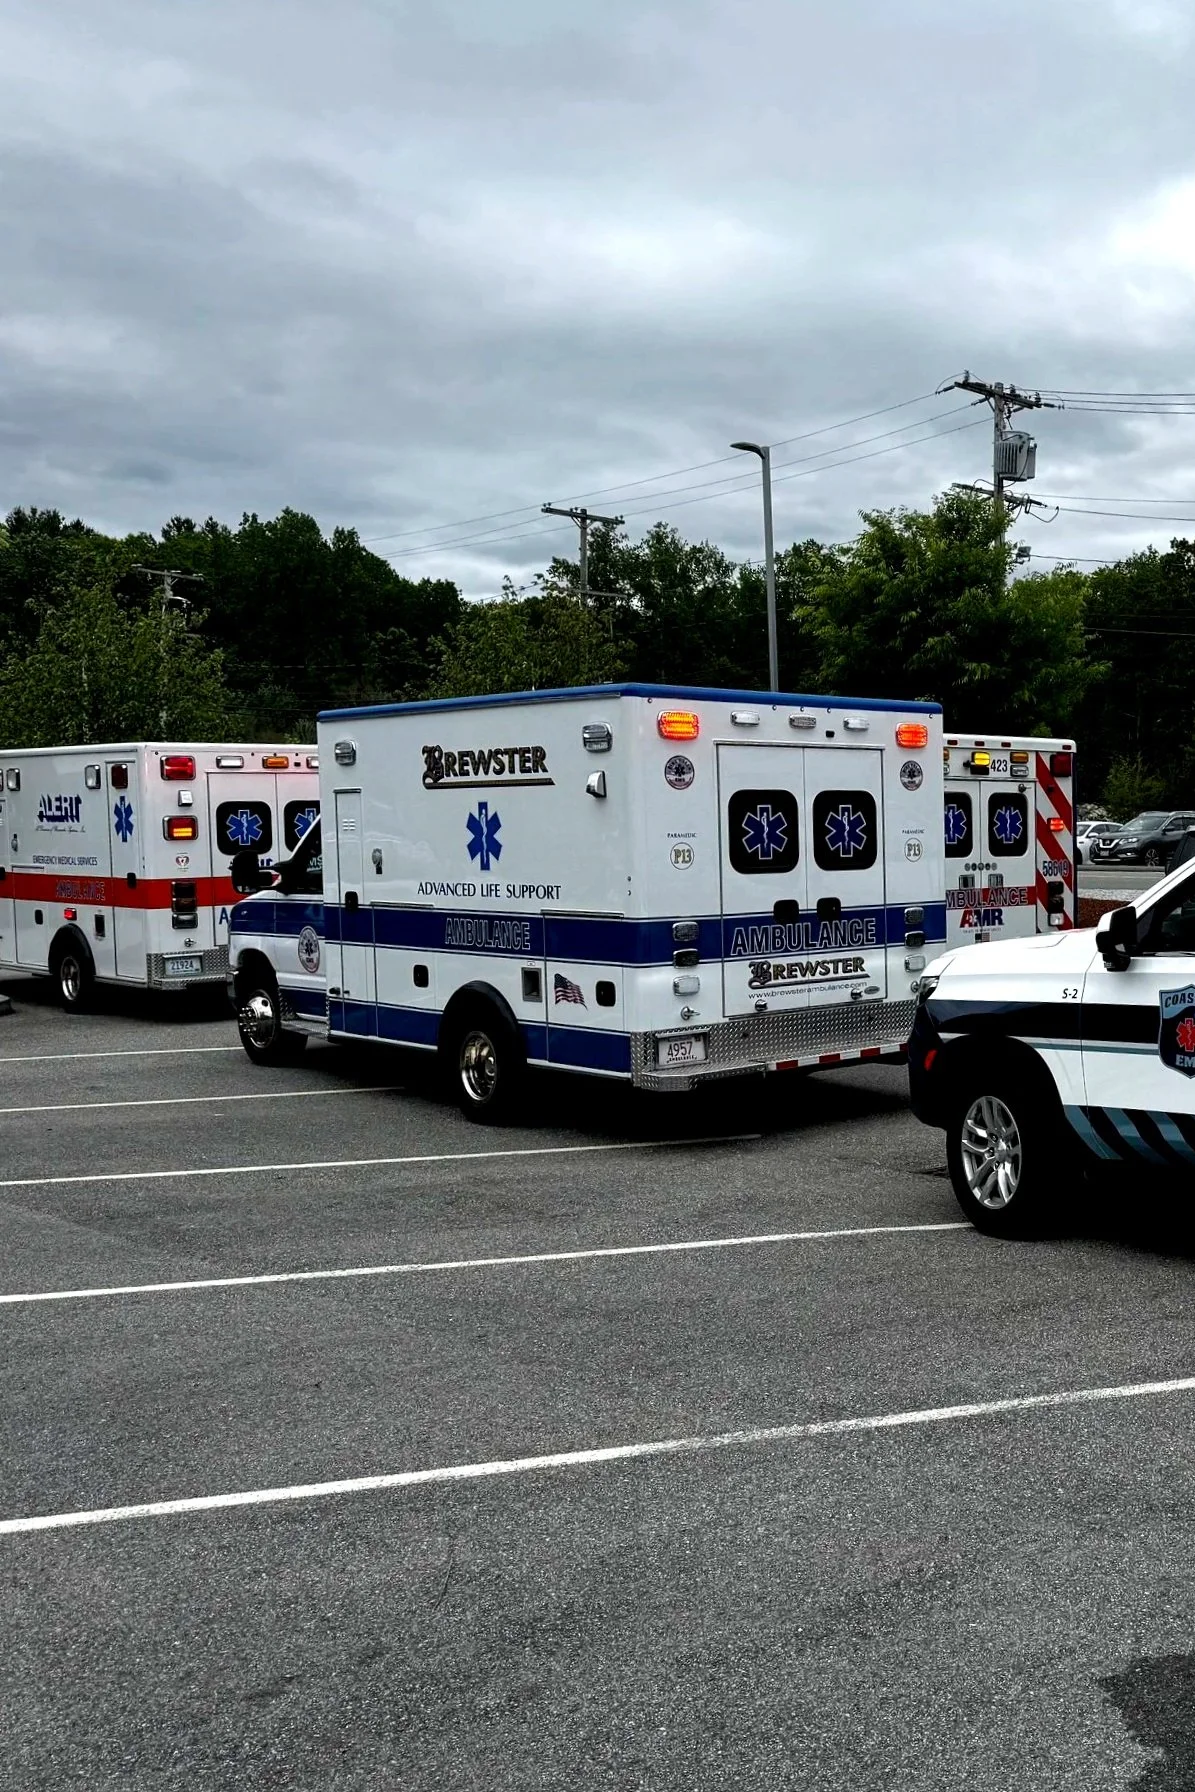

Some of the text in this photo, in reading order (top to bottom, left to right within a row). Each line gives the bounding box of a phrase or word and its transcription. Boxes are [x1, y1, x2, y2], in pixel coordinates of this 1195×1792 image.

[421, 744, 549, 788] BREWSTER
[990, 759, 1008, 773] 423
[37, 793, 83, 824] ALERT
[673, 848, 692, 864] P13
[906, 842, 921, 857] P13
[417, 881, 562, 900] ADVANCED LIFE SUPPORT
[945, 887, 1028, 909] MBULANCE
[959, 908, 1004, 928] AMR
[444, 917, 531, 950] AMBULANCE
[730, 917, 876, 956] AMBULANCE
[748, 956, 866, 987] BREWSTER
[748, 981, 868, 1000] www.brewsterambulance.com
[1062, 988, 1078, 999] S-2
[667, 1041, 693, 1057] 4957
